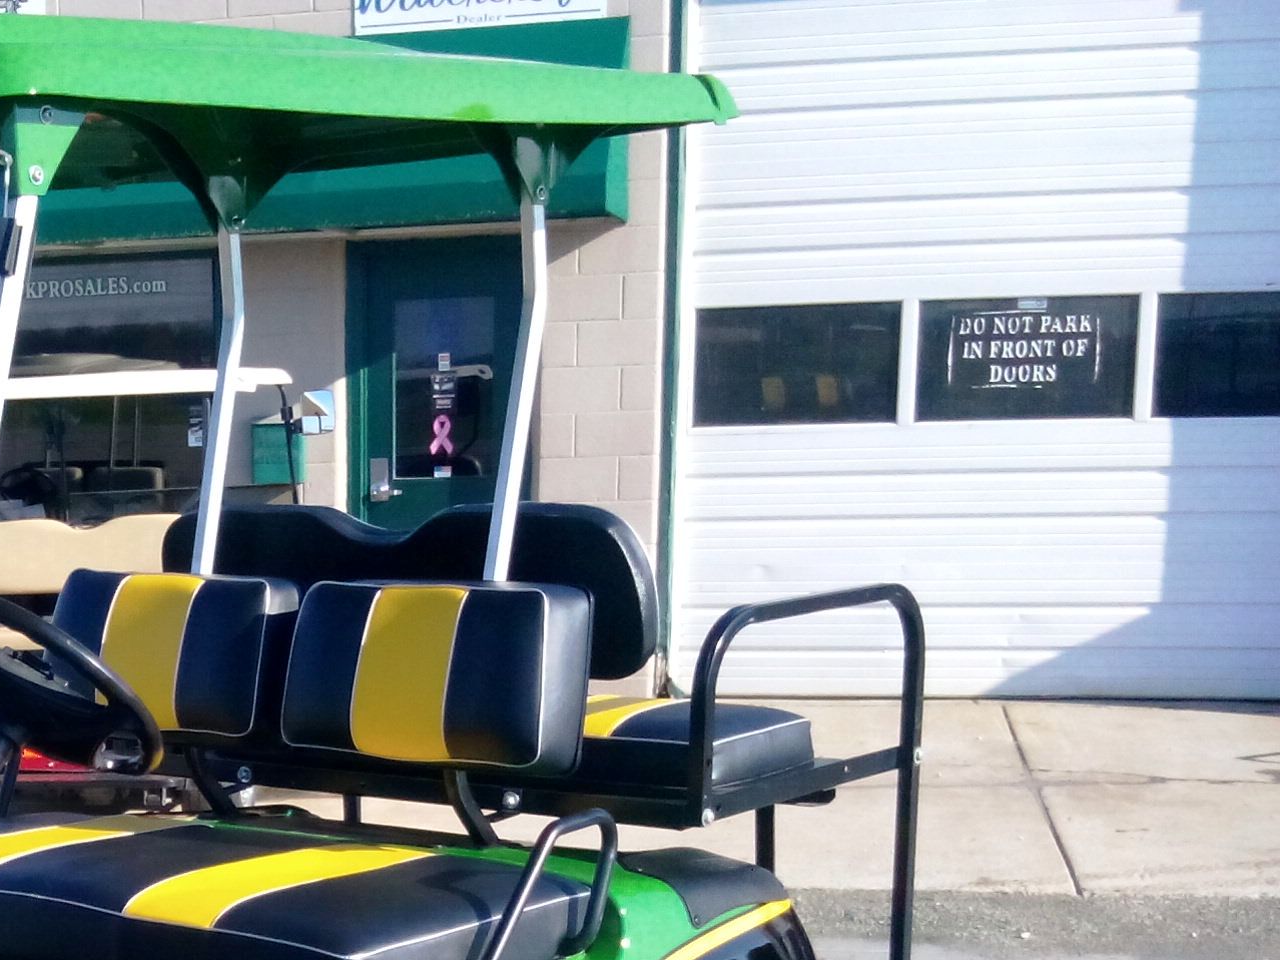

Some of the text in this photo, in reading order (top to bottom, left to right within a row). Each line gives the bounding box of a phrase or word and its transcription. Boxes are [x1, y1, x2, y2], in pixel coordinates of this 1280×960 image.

[456, 13, 503, 25] Dealer
[958, 314, 1093, 336] DO NOT PARK
[962, 338, 1089, 359] IN FRONT OF
[988, 363, 1058, 383] DOORS
